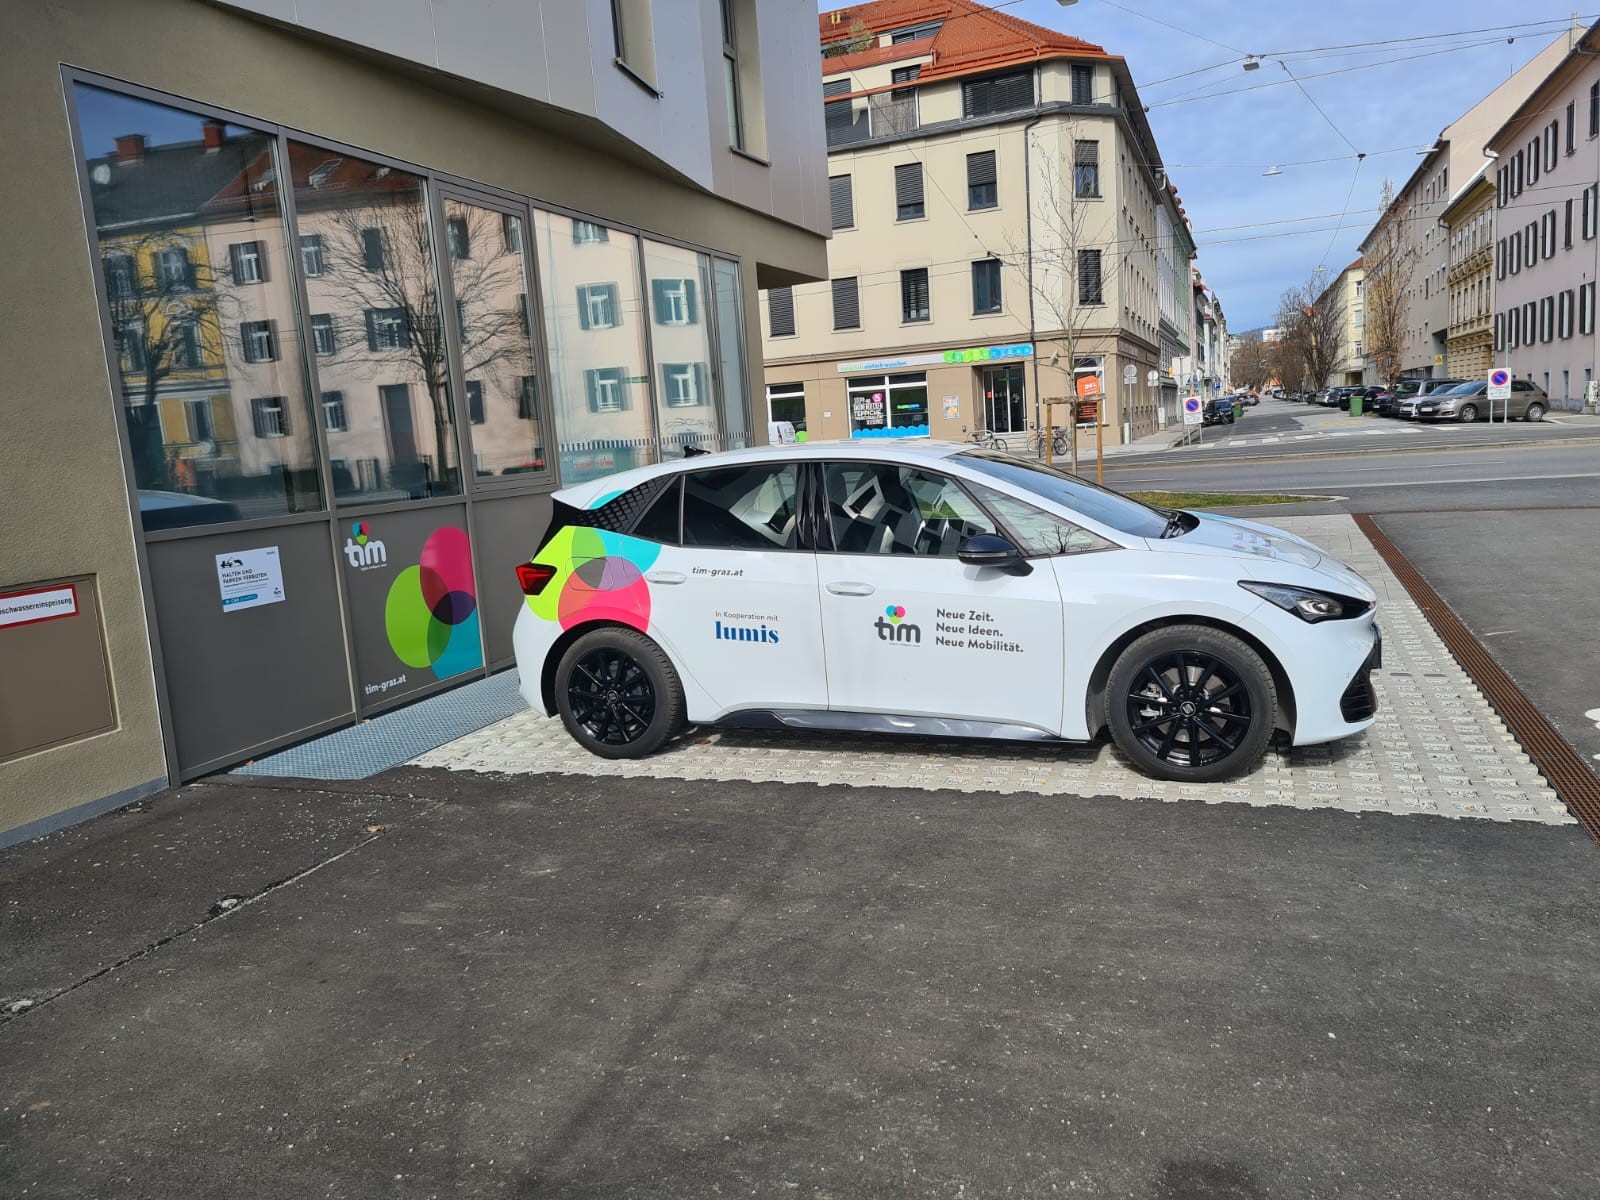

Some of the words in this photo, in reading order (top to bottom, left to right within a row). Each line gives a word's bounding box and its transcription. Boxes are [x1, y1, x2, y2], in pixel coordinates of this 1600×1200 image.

[344, 537, 387, 567] tim
[222, 570, 241, 578] HALTEN
[243, 572, 268, 580] VERBOTEN
[692, 566, 744, 577] tim-graz.at
[0, 598, 72, 614] schwassereinspeisung
[723, 611, 765, 621] Kooperation
[936, 608, 966, 620] Neue
[968, 610, 994, 622] Zeit.
[715, 621, 779, 644] lumis
[874, 616, 921, 643] tim
[936, 622, 965, 634] Neue
[968, 625, 1004, 637] Ideen.
[935, 636, 965, 648] Neue
[967, 638, 1024, 653] Mobilität.
[365, 674, 407, 695] tim-graz.at
